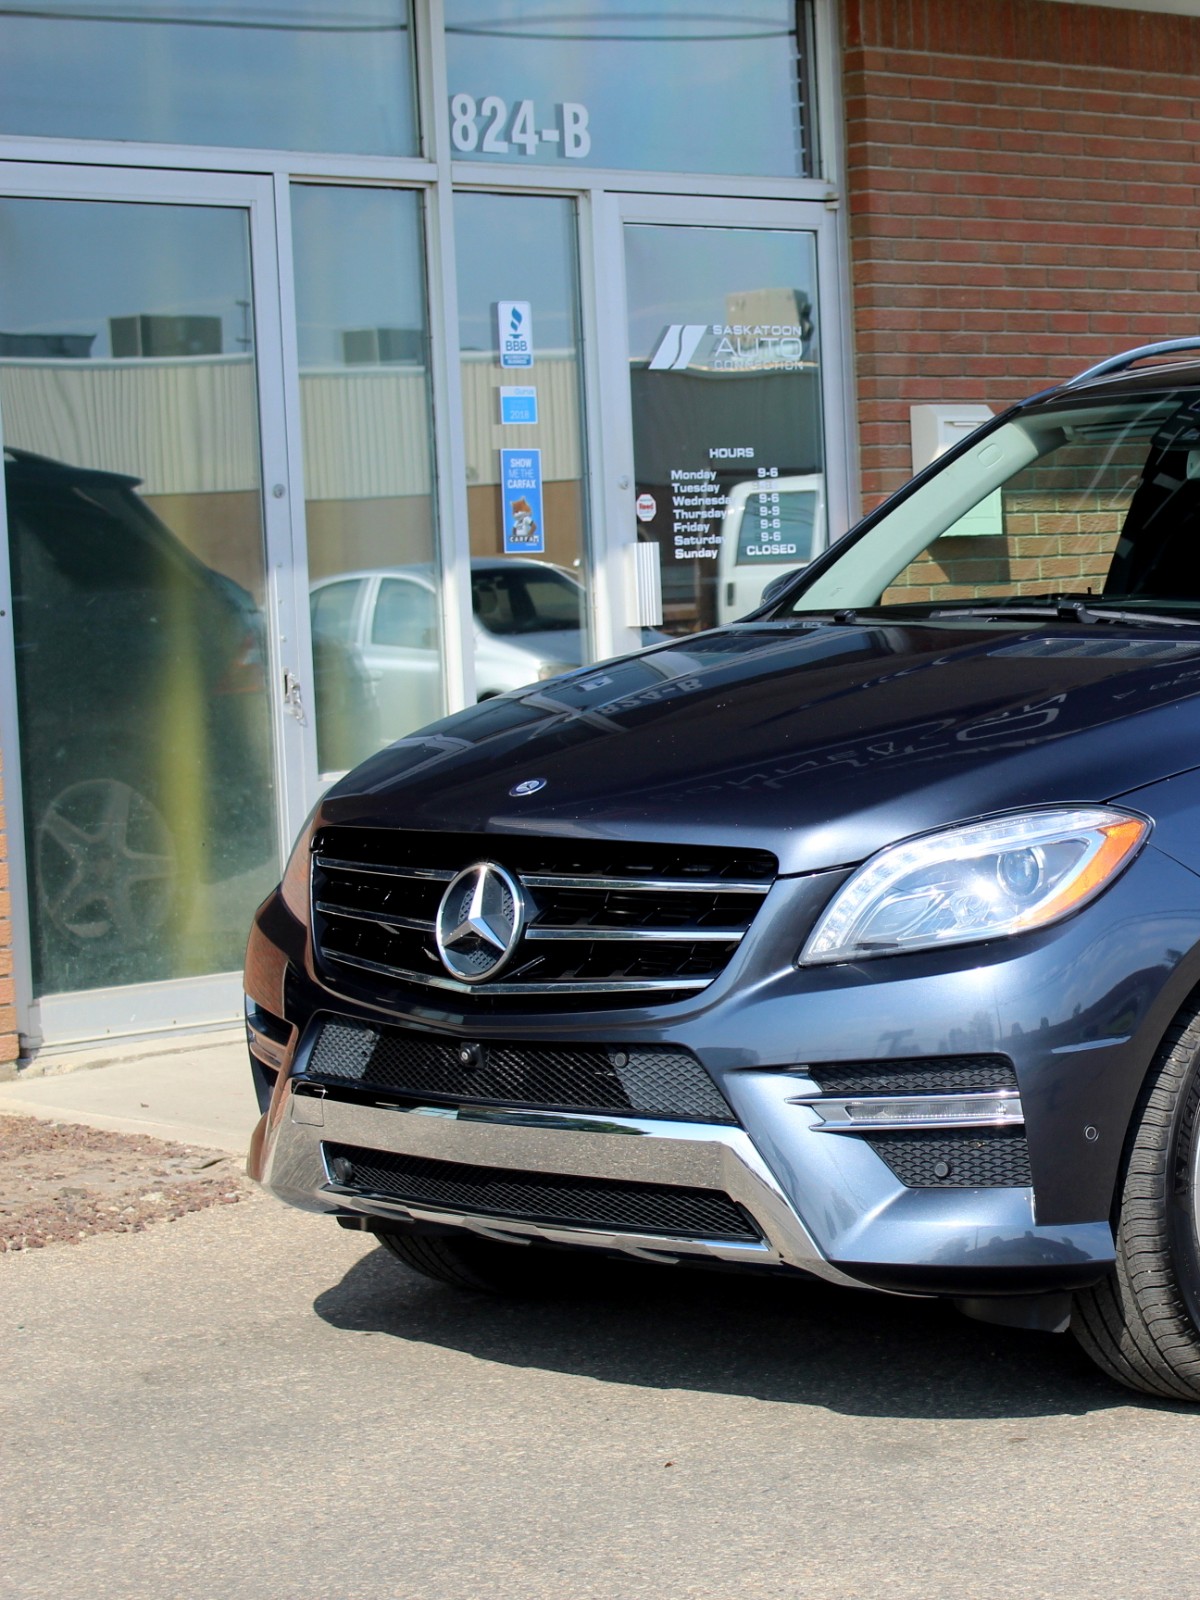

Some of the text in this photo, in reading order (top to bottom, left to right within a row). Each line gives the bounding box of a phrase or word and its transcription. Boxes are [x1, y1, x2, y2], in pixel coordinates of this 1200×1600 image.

[451, 93, 591, 158] 824-B
[712, 325, 802, 336] SASKATOON
[505, 340, 528, 352] BBB
[714, 337, 803, 358] AUTO
[713, 360, 804, 370] CONNECTION
[509, 410, 530, 420] 2018
[709, 447, 754, 458] HOURS
[510, 458, 532, 468] SHOW
[508, 469, 534, 478] ME THE
[671, 467, 779, 481] Monday 9-6
[507, 479, 537, 489] CARFAX
[671, 482, 720, 494] Tuesday
[672, 493, 780, 506] Wednesda 9-6
[672, 506, 780, 520] Thursday 9-9
[673, 519, 781, 533] Friday 9-6
[674, 531, 781, 546] Saturday 9-6
[674, 543, 797, 559] Sunday CLOSED
